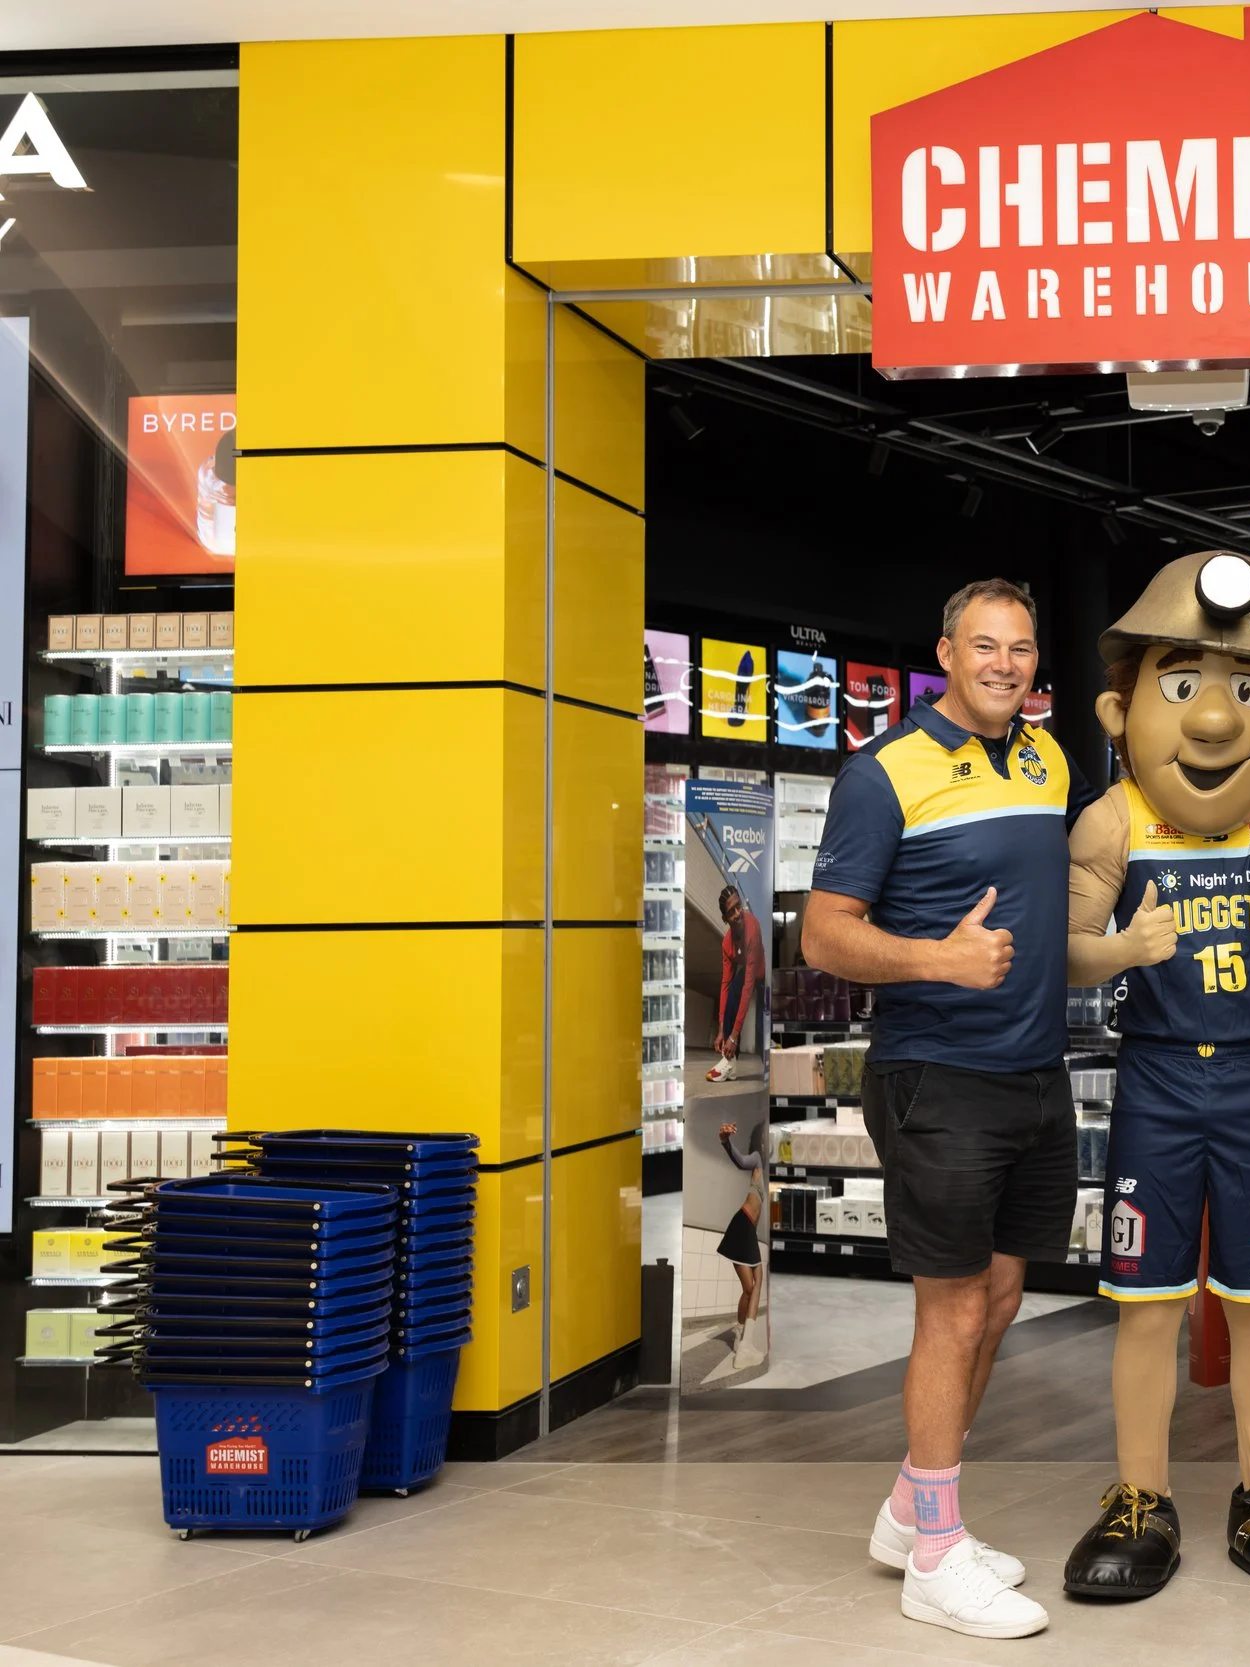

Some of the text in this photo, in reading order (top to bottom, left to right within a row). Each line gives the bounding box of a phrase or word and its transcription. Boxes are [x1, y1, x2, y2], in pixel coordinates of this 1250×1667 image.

[790, 624, 826, 643] ULTRA
[707, 689, 753, 702] CAROLINA
[850, 681, 897, 697] TOM FORD
[723, 825, 766, 846] Reebok
[1190, 873, 1227, 889] Night
[1194, 942, 1247, 994] 15
[1112, 1216, 1138, 1251] GJ
[210, 1449, 265, 1462] CHEMIST
